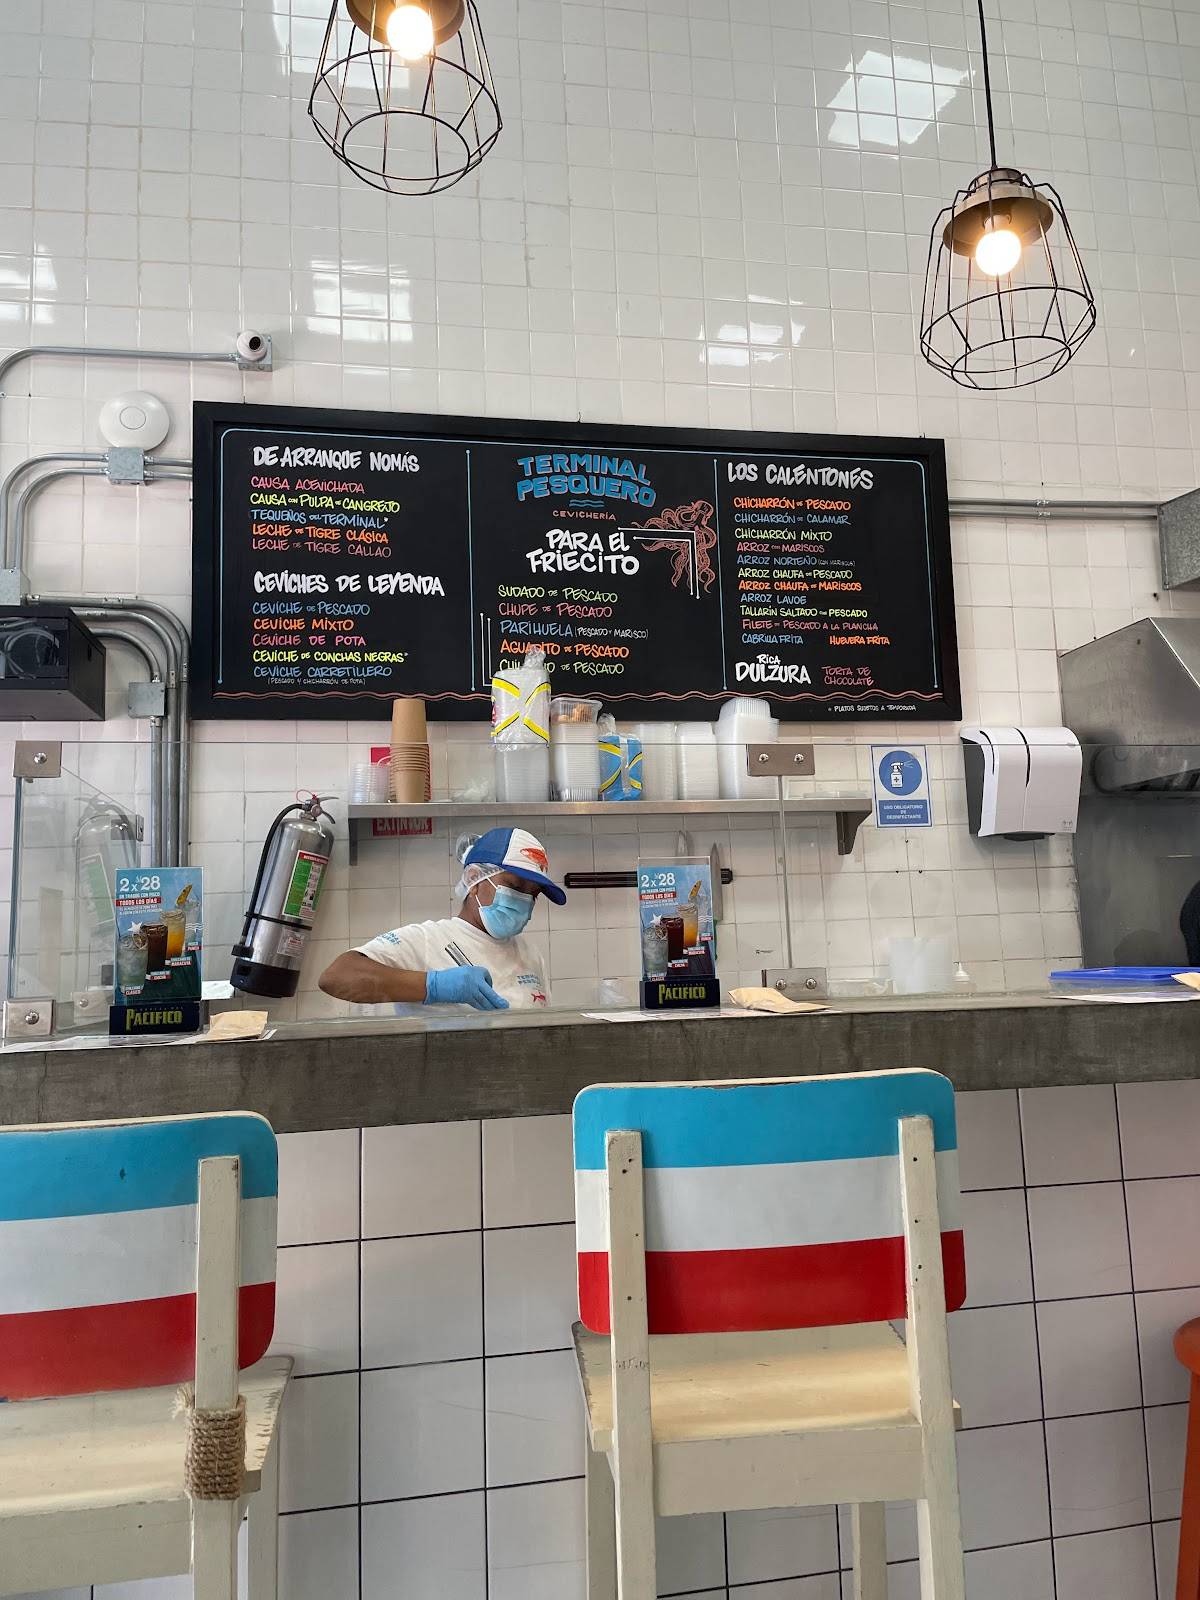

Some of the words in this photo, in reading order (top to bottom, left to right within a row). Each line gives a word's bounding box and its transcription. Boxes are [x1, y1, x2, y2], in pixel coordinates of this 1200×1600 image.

[253, 446, 280, 466] DE
[281, 447, 362, 470] ARRANQUE
[370, 451, 420, 472] NOMÁS
[517, 453, 651, 486] TERMINAL
[727, 462, 758, 483] LOS
[765, 464, 874, 490] CALENTONES
[251, 476, 290, 490] CAUSA
[295, 479, 365, 494] ACEVICHADA
[516, 475, 657, 508] PESQUERO
[250, 493, 287, 506] CAUSA
[299, 494, 335, 509] PULPA
[342, 498, 400, 513] CANGREJO
[733, 496, 796, 510] CHICHARRÓN
[806, 499, 851, 511] PESCADO
[250, 509, 306, 524] TEQUEÑOS
[552, 509, 616, 521] CEVICHERÍA
[734, 512, 796, 524] CHICHARRÓN
[806, 514, 851, 525] CALAMAR
[253, 524, 292, 537] LECHE
[305, 526, 341, 540] TIGRE
[346, 528, 388, 544] CLÁSICA
[545, 528, 604, 552] PARA
[608, 532, 631, 552] EL
[734, 527, 796, 541] CHICHARRÓN
[801, 529, 832, 542] MIXTO
[253, 538, 290, 551] LECHE
[304, 540, 341, 554] TIGRE
[348, 544, 391, 558] CALLAO
[736, 542, 770, 553] ARROZ
[782, 543, 825, 553] MARISCOS
[525, 548, 640, 575] FRIECITO
[736, 555, 770, 565] ARROZ
[773, 556, 818, 566] NORTEÑO
[738, 568, 770, 578] ARROZ
[773, 568, 805, 579] CHAUFA
[813, 569, 853, 580] PESCADO
[253, 569, 329, 594] CEVICHES
[335, 574, 361, 592] DE
[367, 571, 445, 596] LEYENDA
[738, 580, 771, 591] ARROZ
[774, 581, 809, 592] CHAUFA
[818, 581, 862, 592] MARISCOS
[498, 585, 545, 599] SUDADO
[562, 587, 618, 603] PESCADO
[740, 593, 772, 603] ARROZ
[777, 595, 807, 605] LAVOE
[252, 601, 302, 615] CEVICHE
[317, 601, 370, 616] PESCADO
[498, 603, 538, 616] CHUPE
[556, 602, 613, 618] PESCADO
[779, 607, 818, 618] SALTADO
[828, 609, 868, 618] PESCADO
[253, 617, 306, 630] CEVICHE
[312, 617, 354, 631] MIXTO
[500, 619, 574, 637] PARIHUELA
[574, 626, 608, 637] (PESCADO
[613, 628, 649, 640] MARISCO)
[742, 619, 773, 630] FILETE
[783, 620, 821, 630] PESCADO
[842, 622, 878, 631] PLANCHA
[252, 634, 301, 646] CEVICHE
[308, 635, 326, 645] DE
[335, 636, 367, 646] POTA
[741, 633, 778, 644] CABRILLA
[779, 634, 804, 645] FRITA
[829, 636, 865, 645] HUEVERA
[866, 635, 890, 645] FRITA
[253, 649, 299, 663] CEVICHE
[314, 651, 361, 663] CONCHAS
[574, 643, 630, 658] PESCADO
[756, 653, 781, 665] RICA
[253, 665, 302, 678] CEVICHE
[307, 664, 392, 678] CARRETILLERO
[560, 663, 570, 671] DE
[573, 662, 624, 676] PESCADO
[735, 662, 812, 685] DULZURA
[822, 666, 853, 676] TORTA
[856, 667, 871, 677] DE
[824, 676, 875, 687] CHOCOLATE
[120, 878, 130, 891] 2
[140, 876, 160, 890] 28
[641, 875, 650, 887] 2
[659, 872, 676, 886] 28
